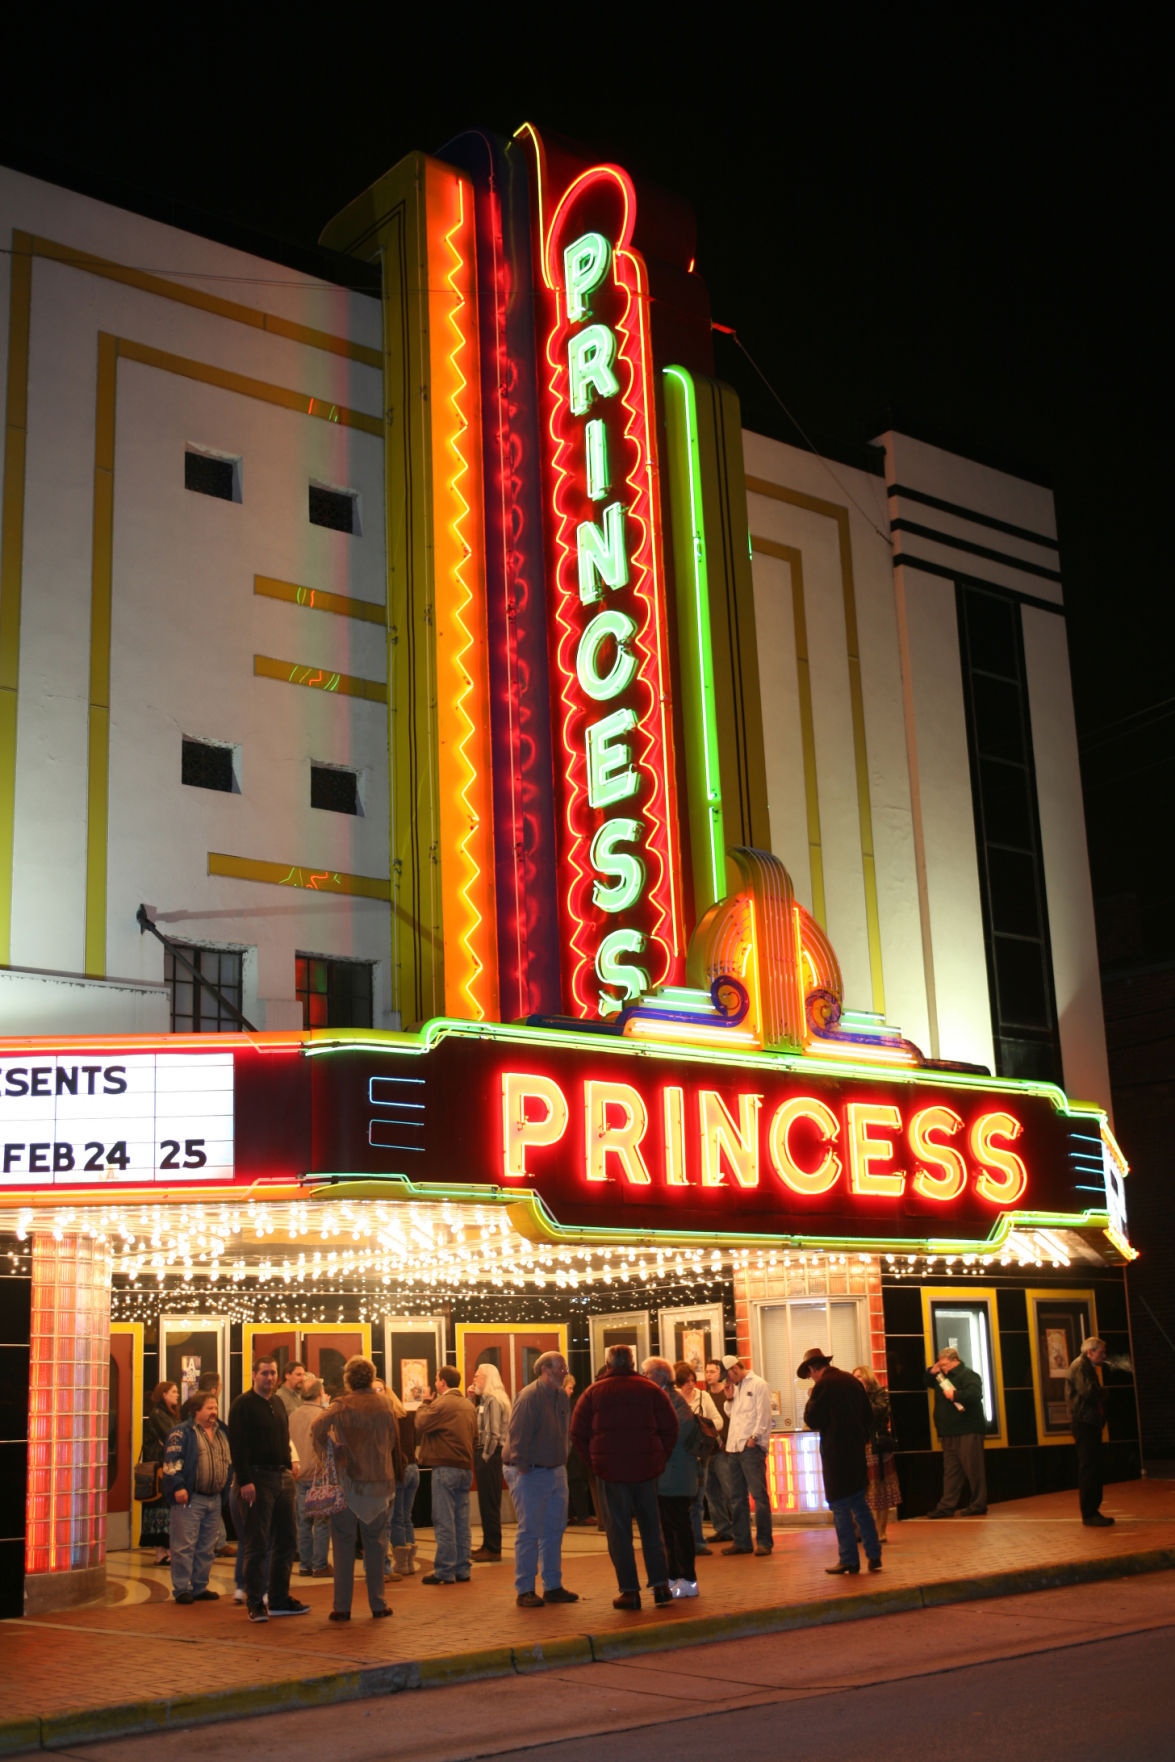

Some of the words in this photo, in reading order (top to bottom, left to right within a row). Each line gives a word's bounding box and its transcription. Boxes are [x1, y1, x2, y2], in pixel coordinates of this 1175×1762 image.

[563, 232, 648, 1017] PRINCESS
[0, 1066, 128, 1097] SENTS
[3, 1142, 76, 1173] FEB
[84, 1140, 130, 1171] 24
[159, 1139, 207, 1169] 25
[501, 1072, 1026, 1203] PRINCESS
